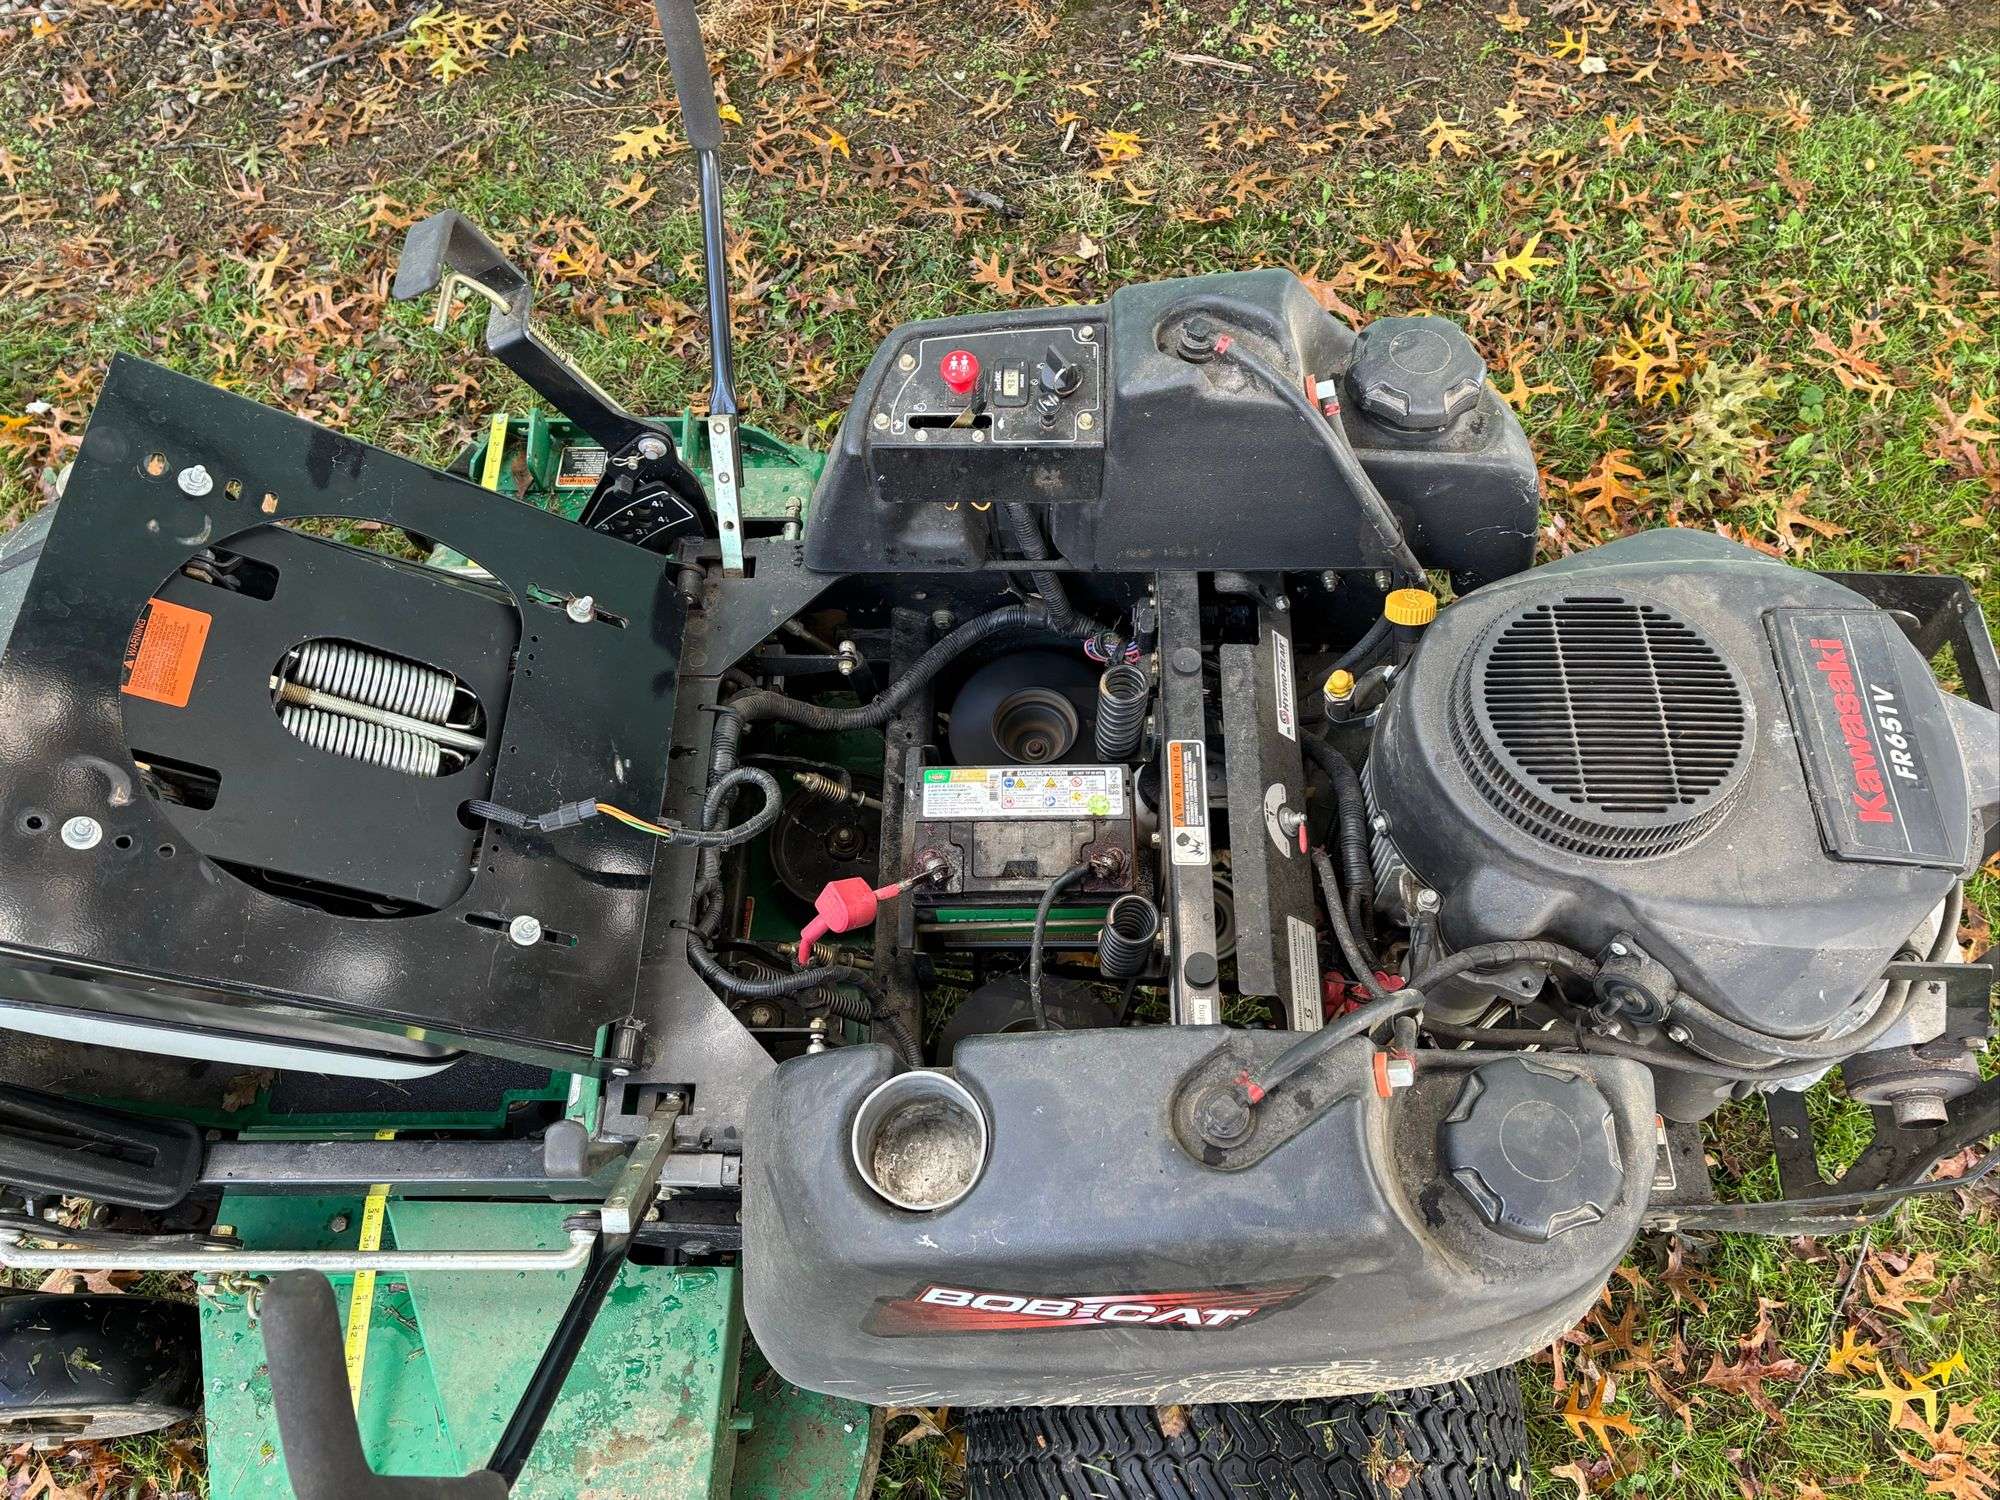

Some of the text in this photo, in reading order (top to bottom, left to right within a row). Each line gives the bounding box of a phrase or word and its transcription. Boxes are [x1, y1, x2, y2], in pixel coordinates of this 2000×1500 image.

[127, 618, 147, 657] WARNING
[1278, 639, 1290, 712] HYDRO-GEAR
[1809, 638, 1893, 823] Kawasaki
[1870, 684, 1918, 780] FR651V
[1173, 745, 1183, 812] WARNING
[367, 1207, 374, 1220] 38
[355, 1294, 363, 1306] 41
[351, 1324, 359, 1337] 42
